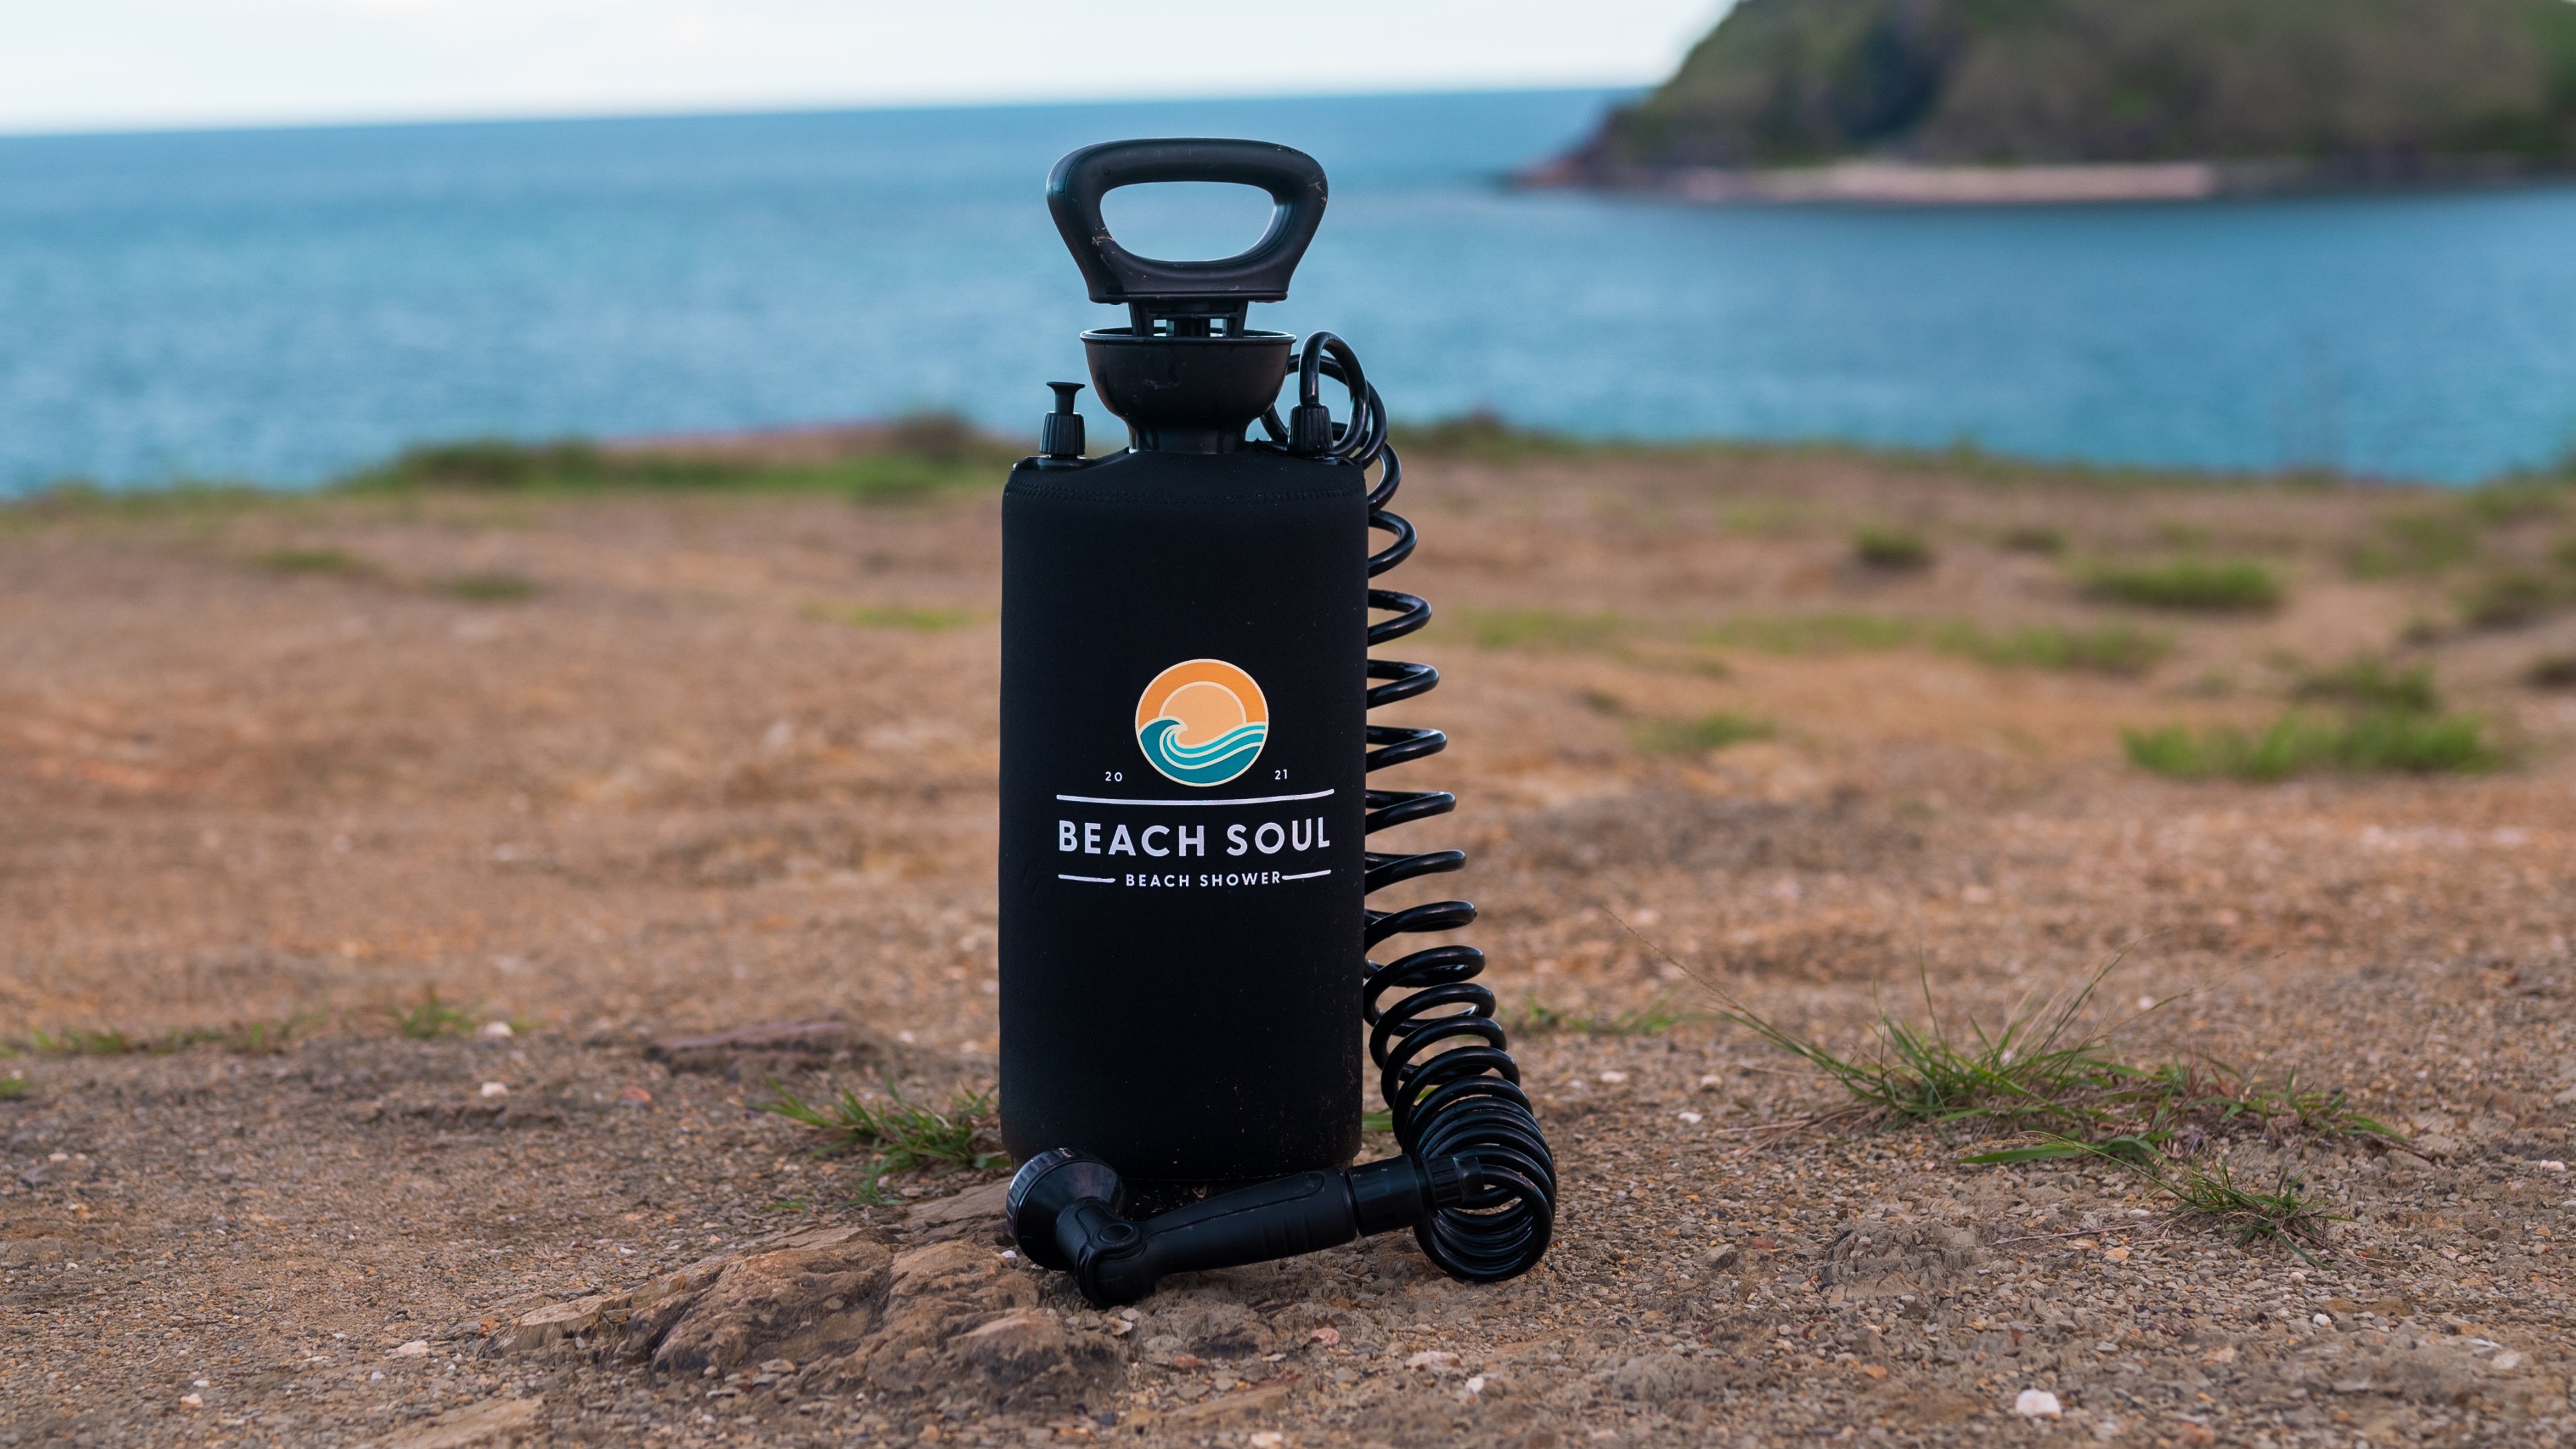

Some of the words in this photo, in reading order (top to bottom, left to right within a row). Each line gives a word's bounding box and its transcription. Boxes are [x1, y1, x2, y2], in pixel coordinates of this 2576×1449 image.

[1105, 771, 1123, 782] 20
[1275, 769, 1287, 780] 21
[1059, 820, 1205, 857] BEACH
[1226, 816, 1330, 856] SOUL
[1126, 873, 1189, 888] BEACH
[1199, 871, 1281, 888] SHOWER
